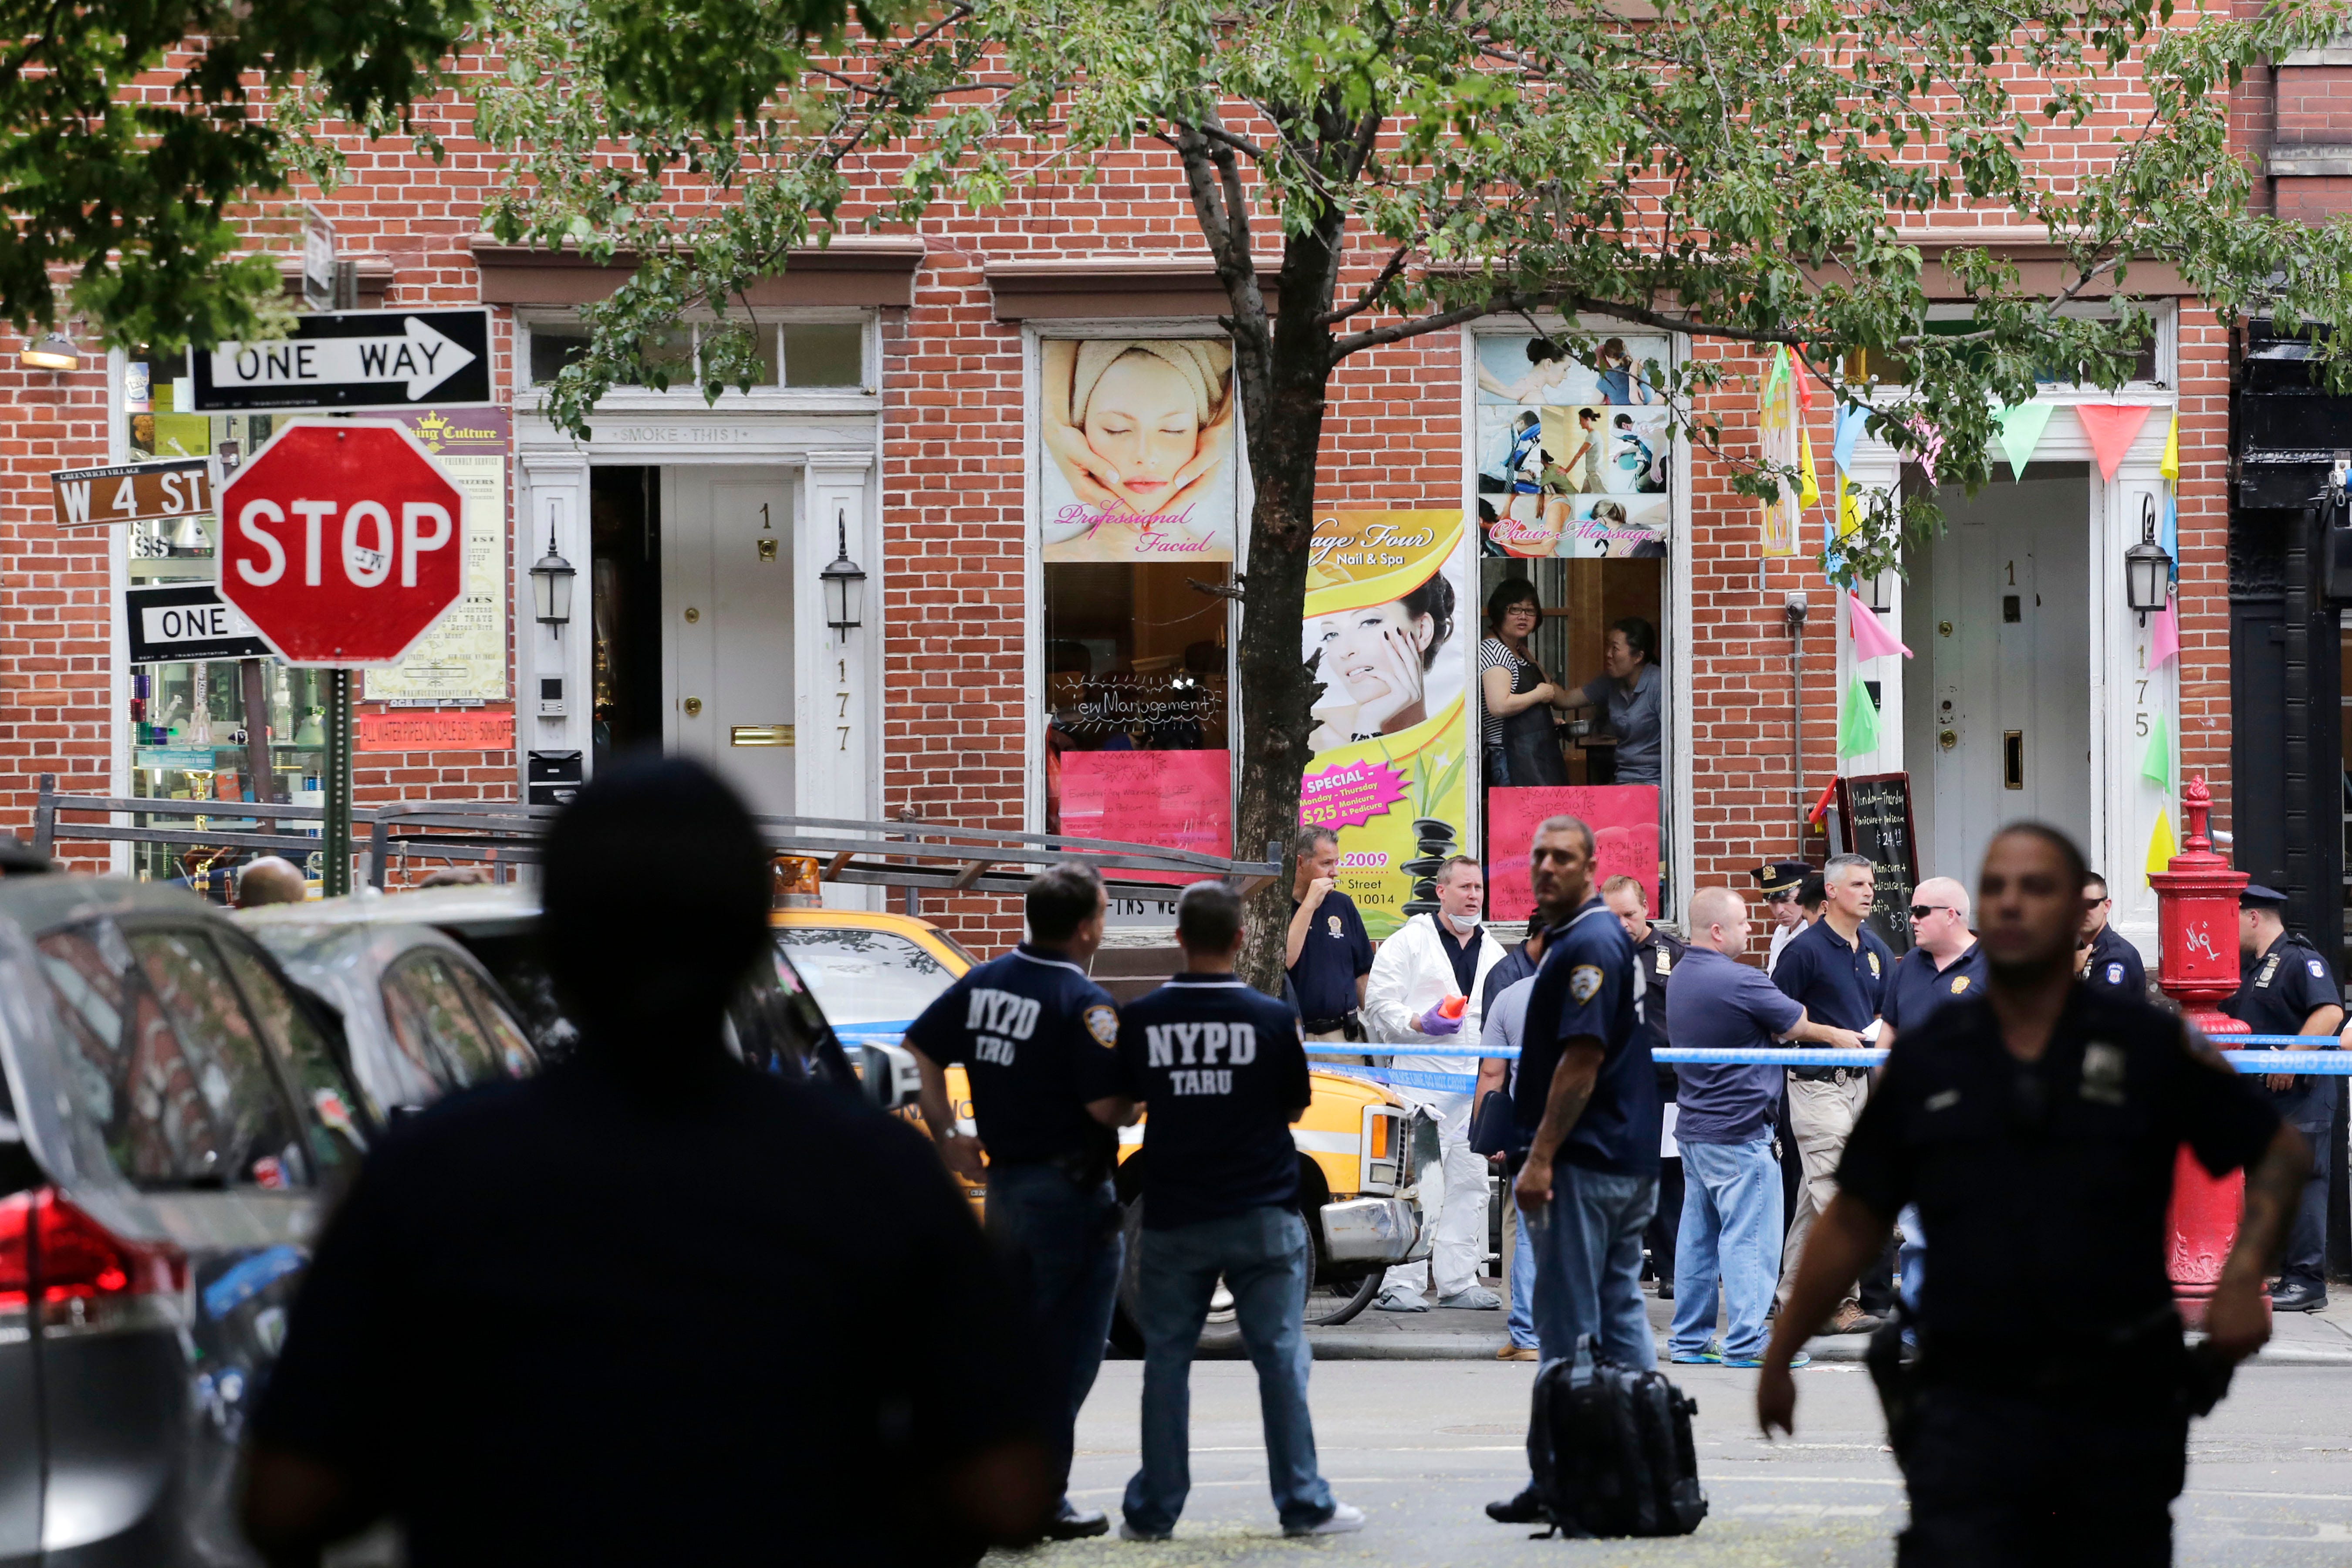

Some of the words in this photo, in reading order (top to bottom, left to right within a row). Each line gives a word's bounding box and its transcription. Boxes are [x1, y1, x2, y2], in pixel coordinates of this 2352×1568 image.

[236, 345, 318, 381] ONE
[359, 342, 443, 378] WAY
[443, 426, 497, 439] Culture
[621, 427, 678, 442] SMOKE
[60, 470, 106, 480] GREENWICH
[108, 467, 141, 476] VILLAGE
[60, 480, 91, 523] W
[112, 476, 138, 517] 4
[161, 470, 204, 514] ST
[760, 503, 771, 529] 1
[1054, 497, 1196, 540] Professional
[236, 499, 452, 588] STOP
[1135, 531, 1214, 552] Facial
[1360, 524, 1433, 547] Four
[1489, 519, 1552, 541] Chair
[1555, 519, 1661, 556] Massage
[1337, 553, 1363, 564] Nail
[1367, 553, 1377, 564] &
[1380, 553, 1404, 568] Spa
[2004, 560, 2015, 586] 1
[162, 608, 228, 638] ONE
[1105, 691, 1210, 720] Management
[497, 721, 511, 740] OFF
[1307, 769, 1364, 794] SPECIAL
[1299, 794, 1333, 807] Monday
[1340, 783, 1378, 797] Thursday
[1531, 795, 1586, 816] Special
[1302, 805, 1337, 825] $25
[1339, 794, 1375, 808] Manicure
[1350, 802, 1383, 815] Pedicure
[1348, 879, 1381, 889] Street
[1358, 894, 1394, 904] 10014
[966, 987, 1041, 1041] NYPD
[1146, 1022, 1257, 1068] NYPD
[2258, 1052, 2318, 1071] CROSS
[1169, 1070, 1233, 1096] TARU
[1388, 1071, 1409, 1084] POLICE
[1409, 1072, 1424, 1085] LINE
[1425, 1073, 1434, 1086] DO
[1435, 1073, 1446, 1088] NOT
[1448, 1075, 1466, 1091] CROSS
